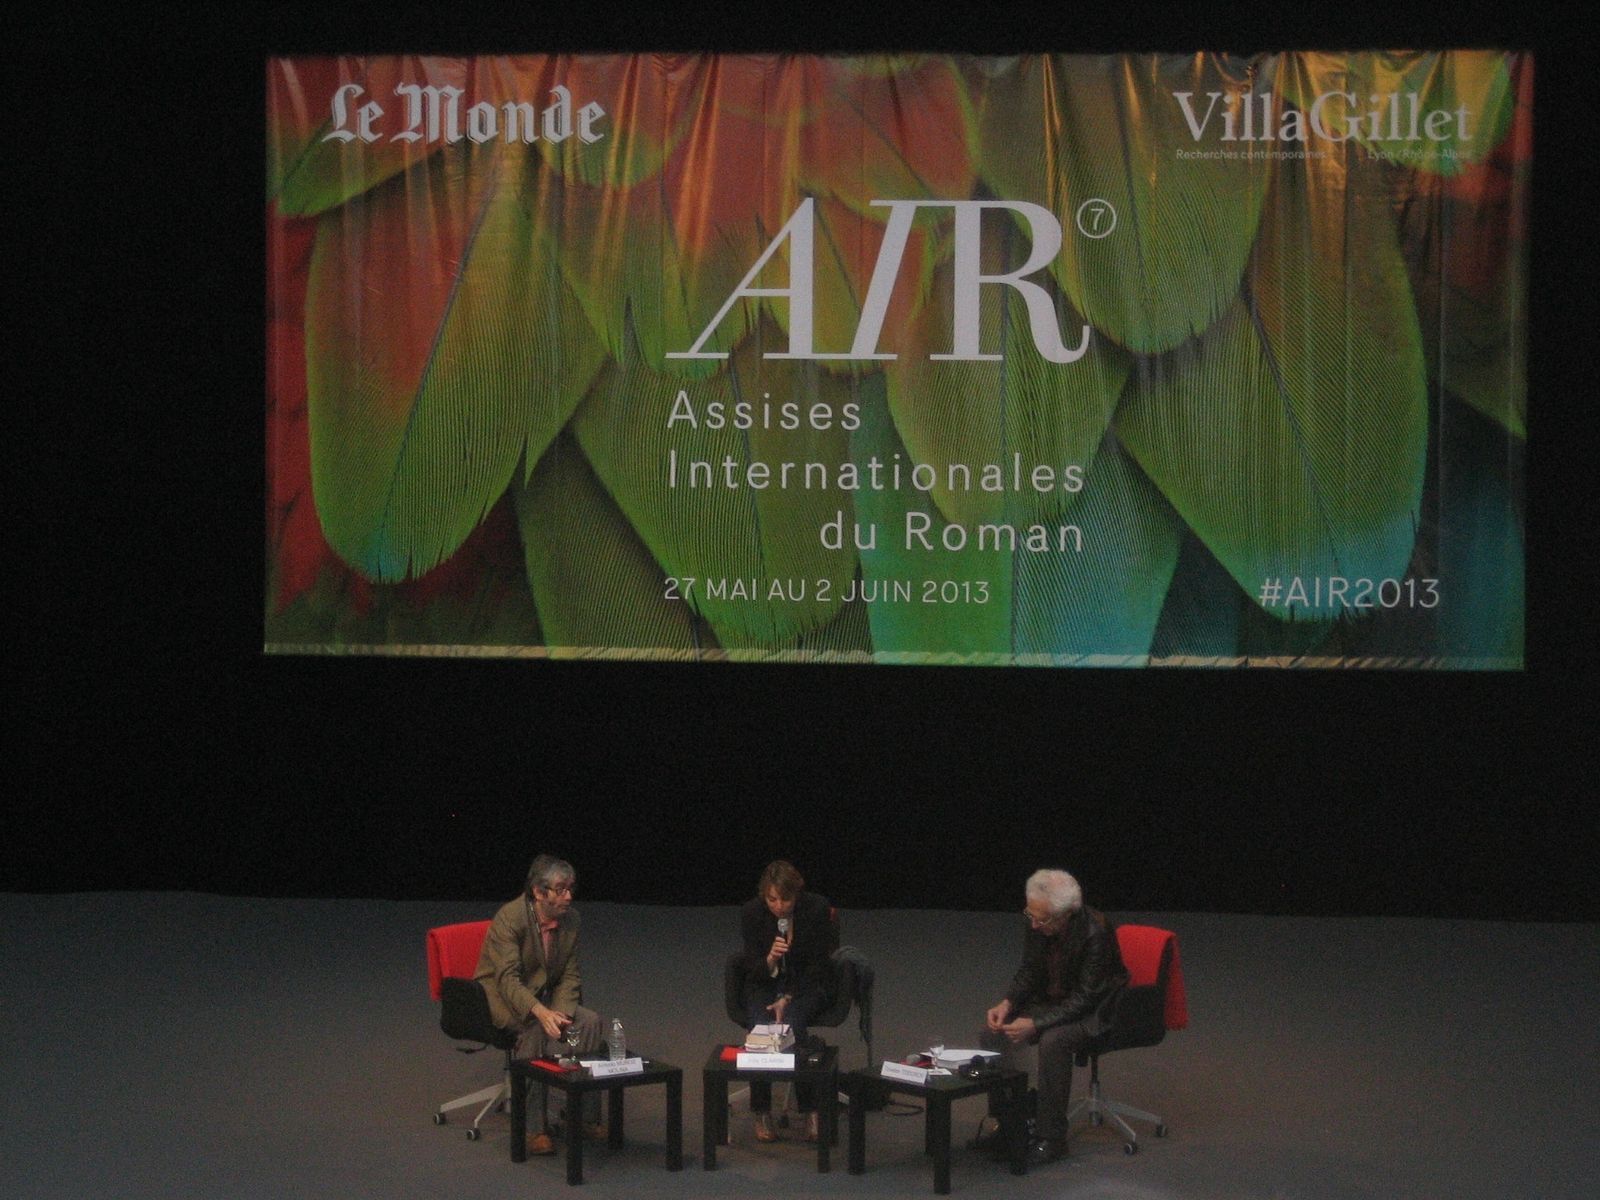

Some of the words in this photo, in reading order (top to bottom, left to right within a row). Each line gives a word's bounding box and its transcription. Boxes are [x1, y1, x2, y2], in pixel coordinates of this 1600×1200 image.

[321, 84, 385, 144] Le
[390, 82, 606, 145] Monde
[665, 197, 1091, 364] AIR
[667, 390, 862, 431] Assises
[668, 449, 1085, 493] Internationales
[819, 510, 877, 550] du
[904, 511, 1083, 552] Roman
[664, 577, 695, 600] 27
[705, 578, 758, 601] MAI
[767, 579, 806, 601] AU
[815, 579, 831, 602] 2
[841, 579, 911, 603] JUIN
[922, 580, 990, 605] 2013
[1258, 576, 1441, 608] #AIR2013
